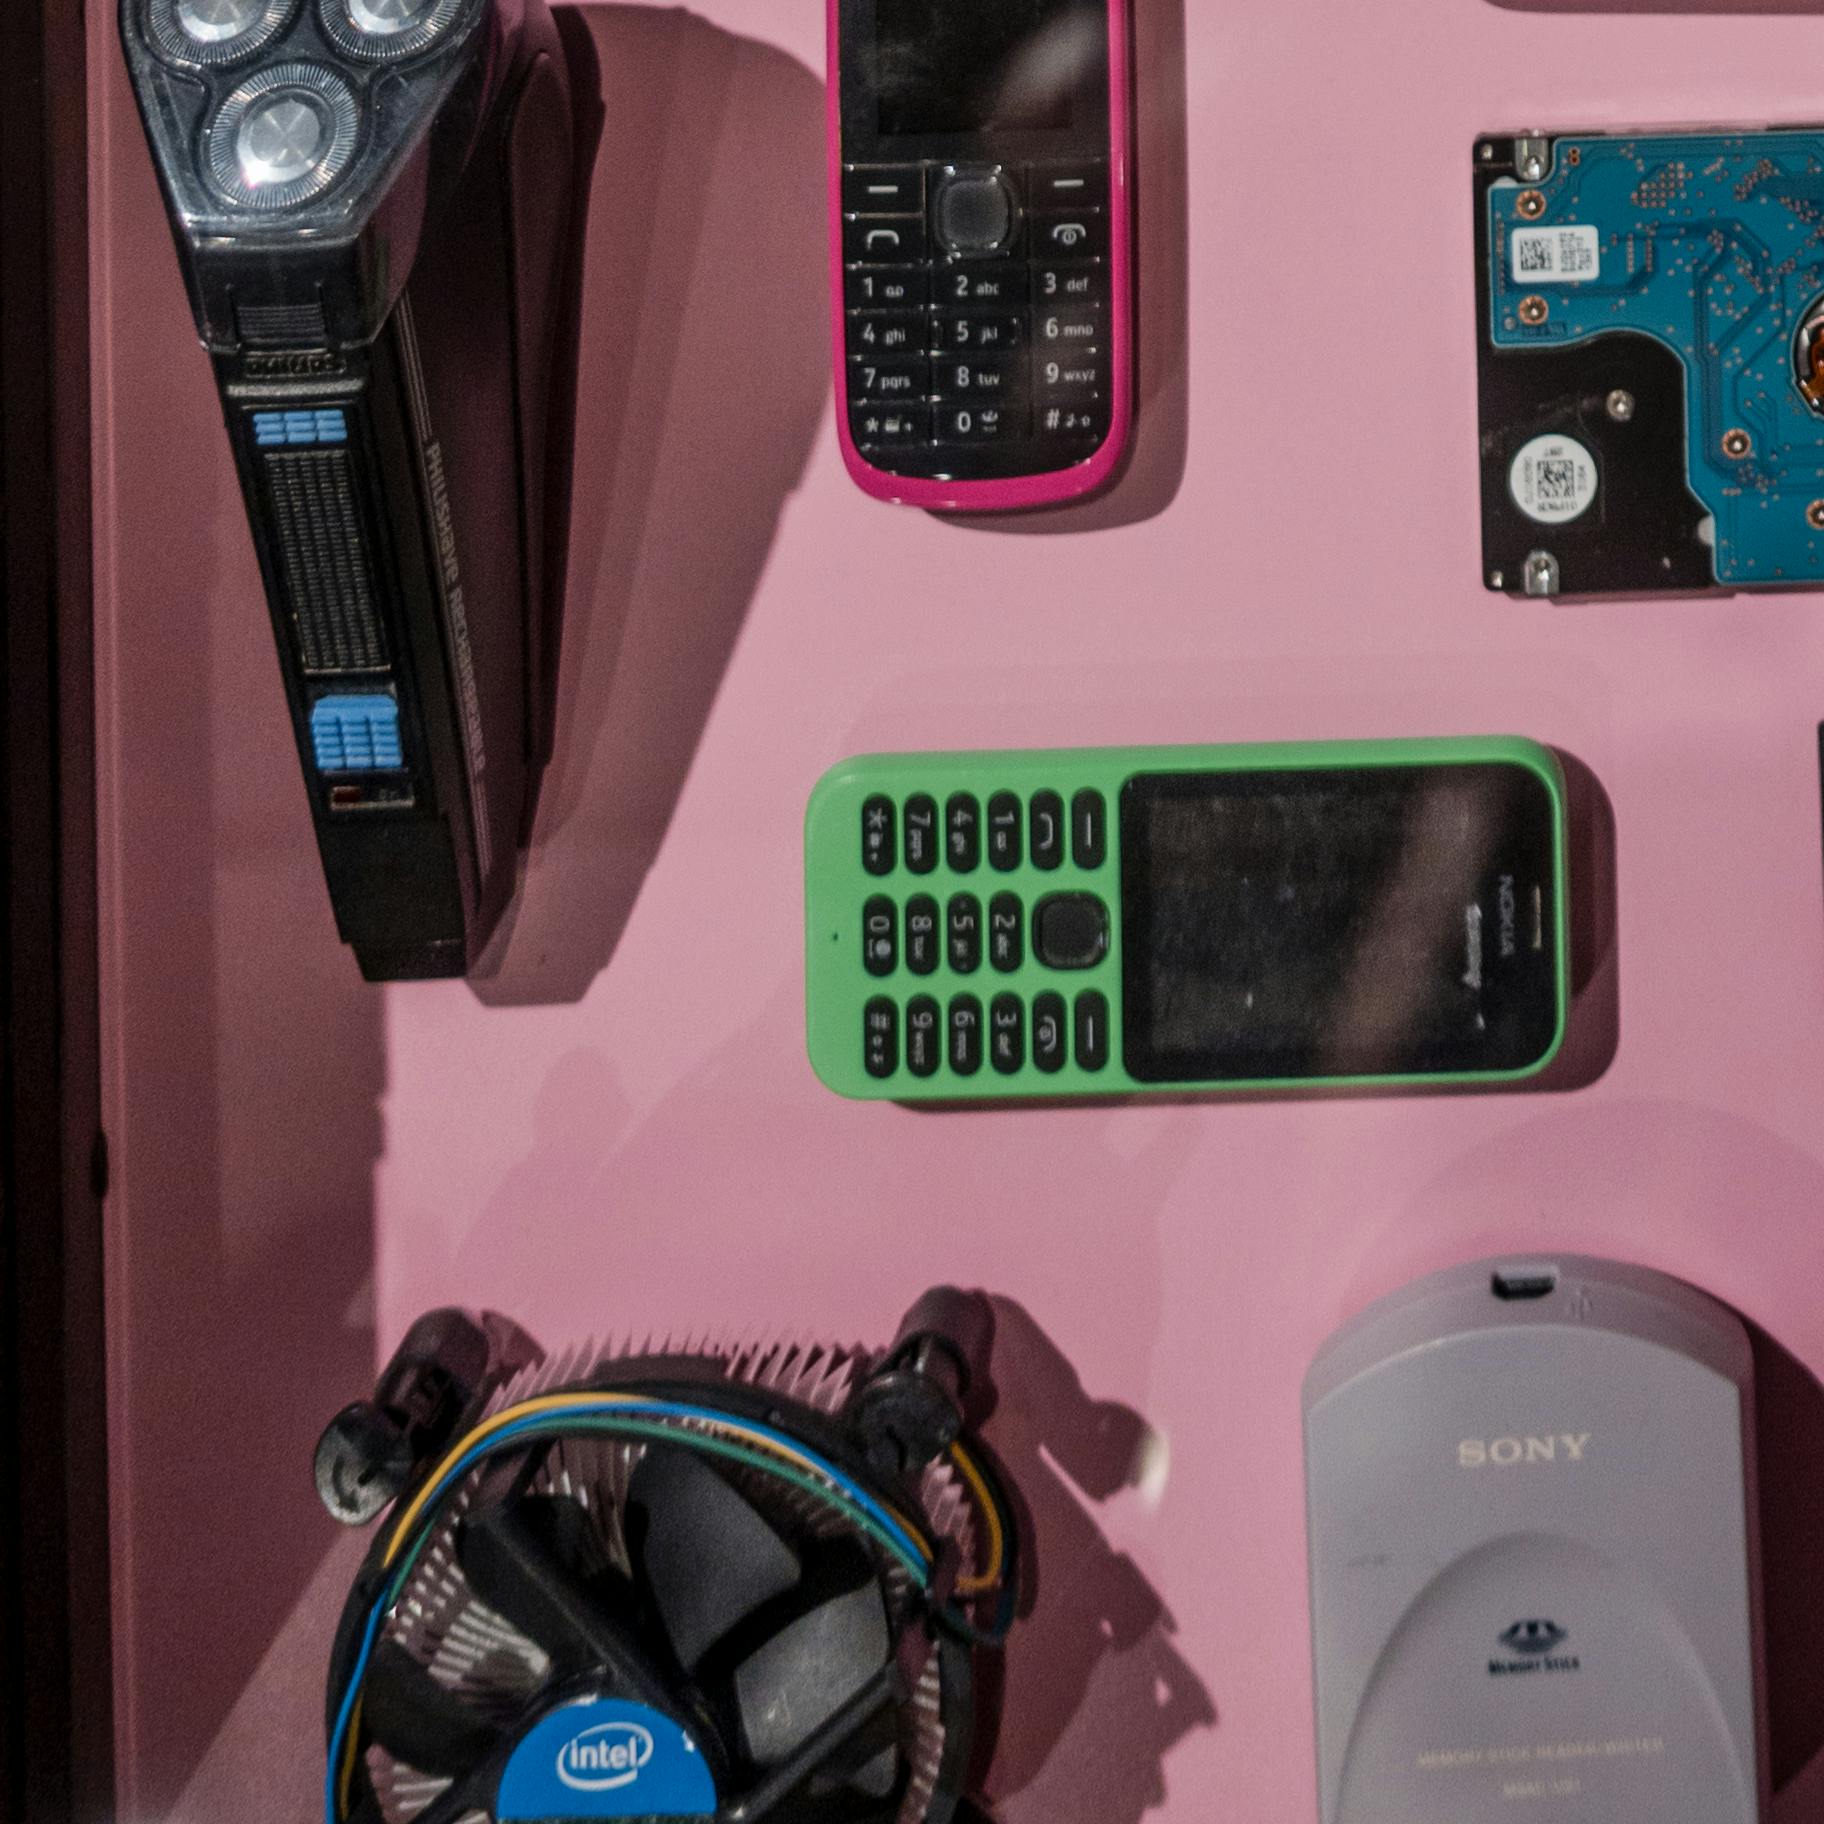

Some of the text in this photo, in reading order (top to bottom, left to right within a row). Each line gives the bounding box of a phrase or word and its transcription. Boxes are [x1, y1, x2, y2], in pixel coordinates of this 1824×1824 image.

[863, 276, 874, 298] 1
[956, 275, 999, 297] 2 abc
[1044, 271, 1090, 295] 3 def
[862, 322, 906, 346] 4 ghi
[956, 320, 998, 344] 5 jkl
[1045, 316, 1094, 338] 6 mno
[863, 367, 911, 392] 7 pqrs
[956, 365, 1000, 387] 8 tuv
[1045, 362, 1060, 384] 9
[957, 411, 972, 433] 0
[909, 810, 931, 827] 7
[952, 809, 974, 826] 4
[994, 810, 1015, 824] 1
[869, 915, 890, 932] 0
[911, 914, 933, 932] 8
[952, 915, 974, 930] 5
[994, 913, 1016, 930] 2
[912, 1011, 933, 1028] 9
[954, 1010, 975, 1027] 6
[996, 1010, 1017, 1026] 3
[1457, 1432, 1593, 1468] SONY
[1487, 1654, 1581, 1677] MEMORY STICK
[569, 1736, 638, 1770] intel
